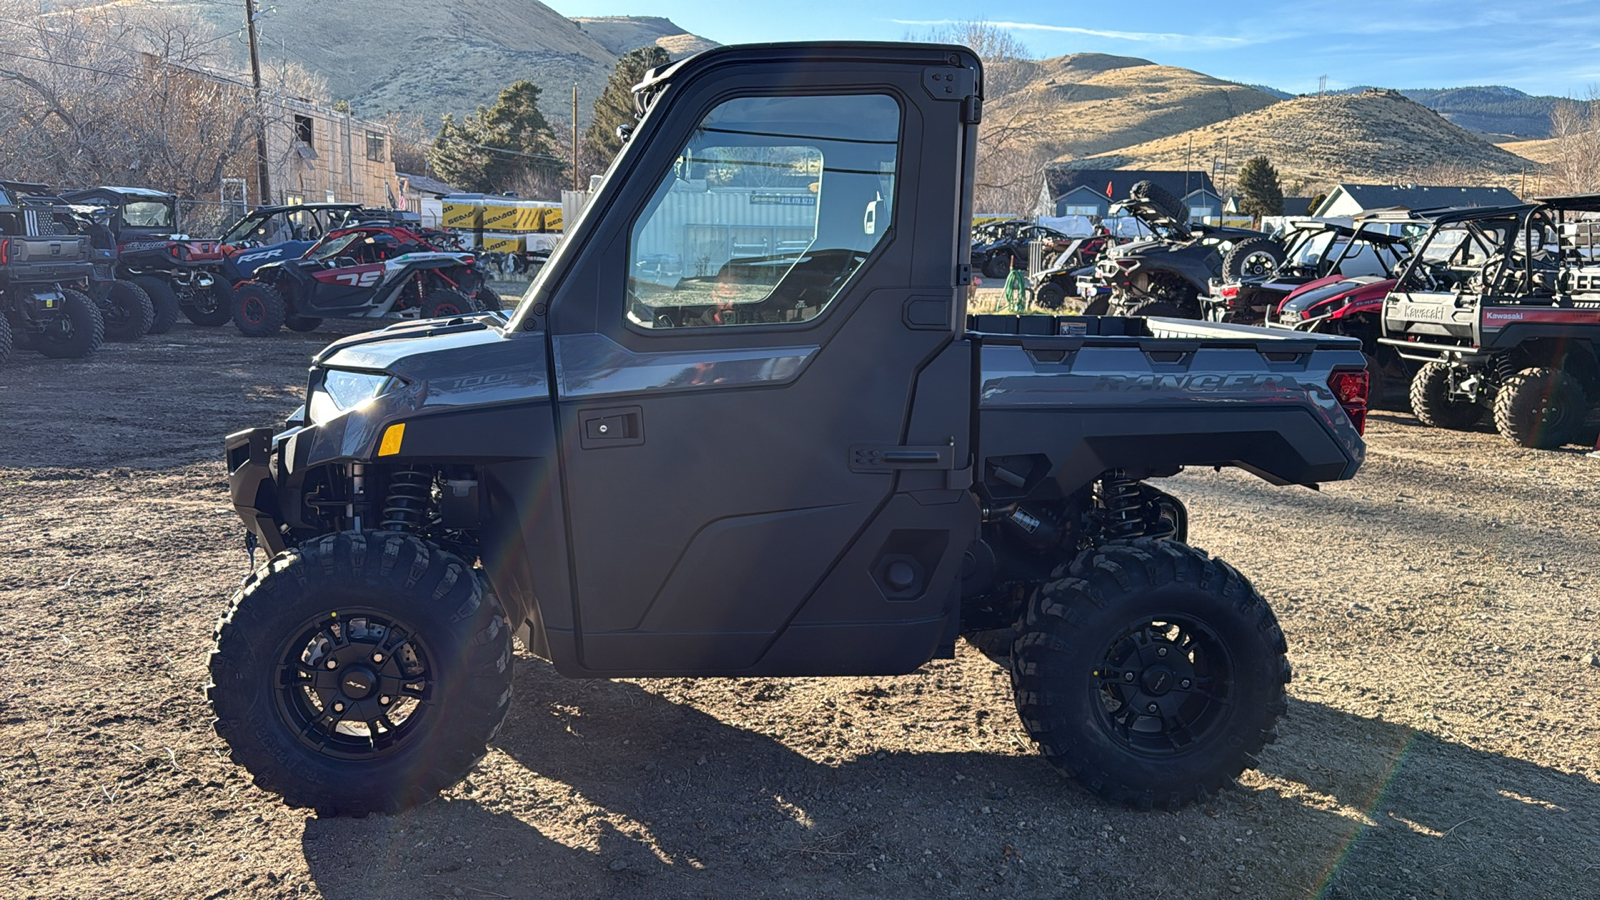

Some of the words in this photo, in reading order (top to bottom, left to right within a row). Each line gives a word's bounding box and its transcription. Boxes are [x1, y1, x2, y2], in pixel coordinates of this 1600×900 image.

[236, 249, 283, 265] RZR
[1404, 305, 1444, 321] Kawasaki
[1486, 311, 1523, 321] Kawasaki
[1093, 373, 1285, 392] RANGER
